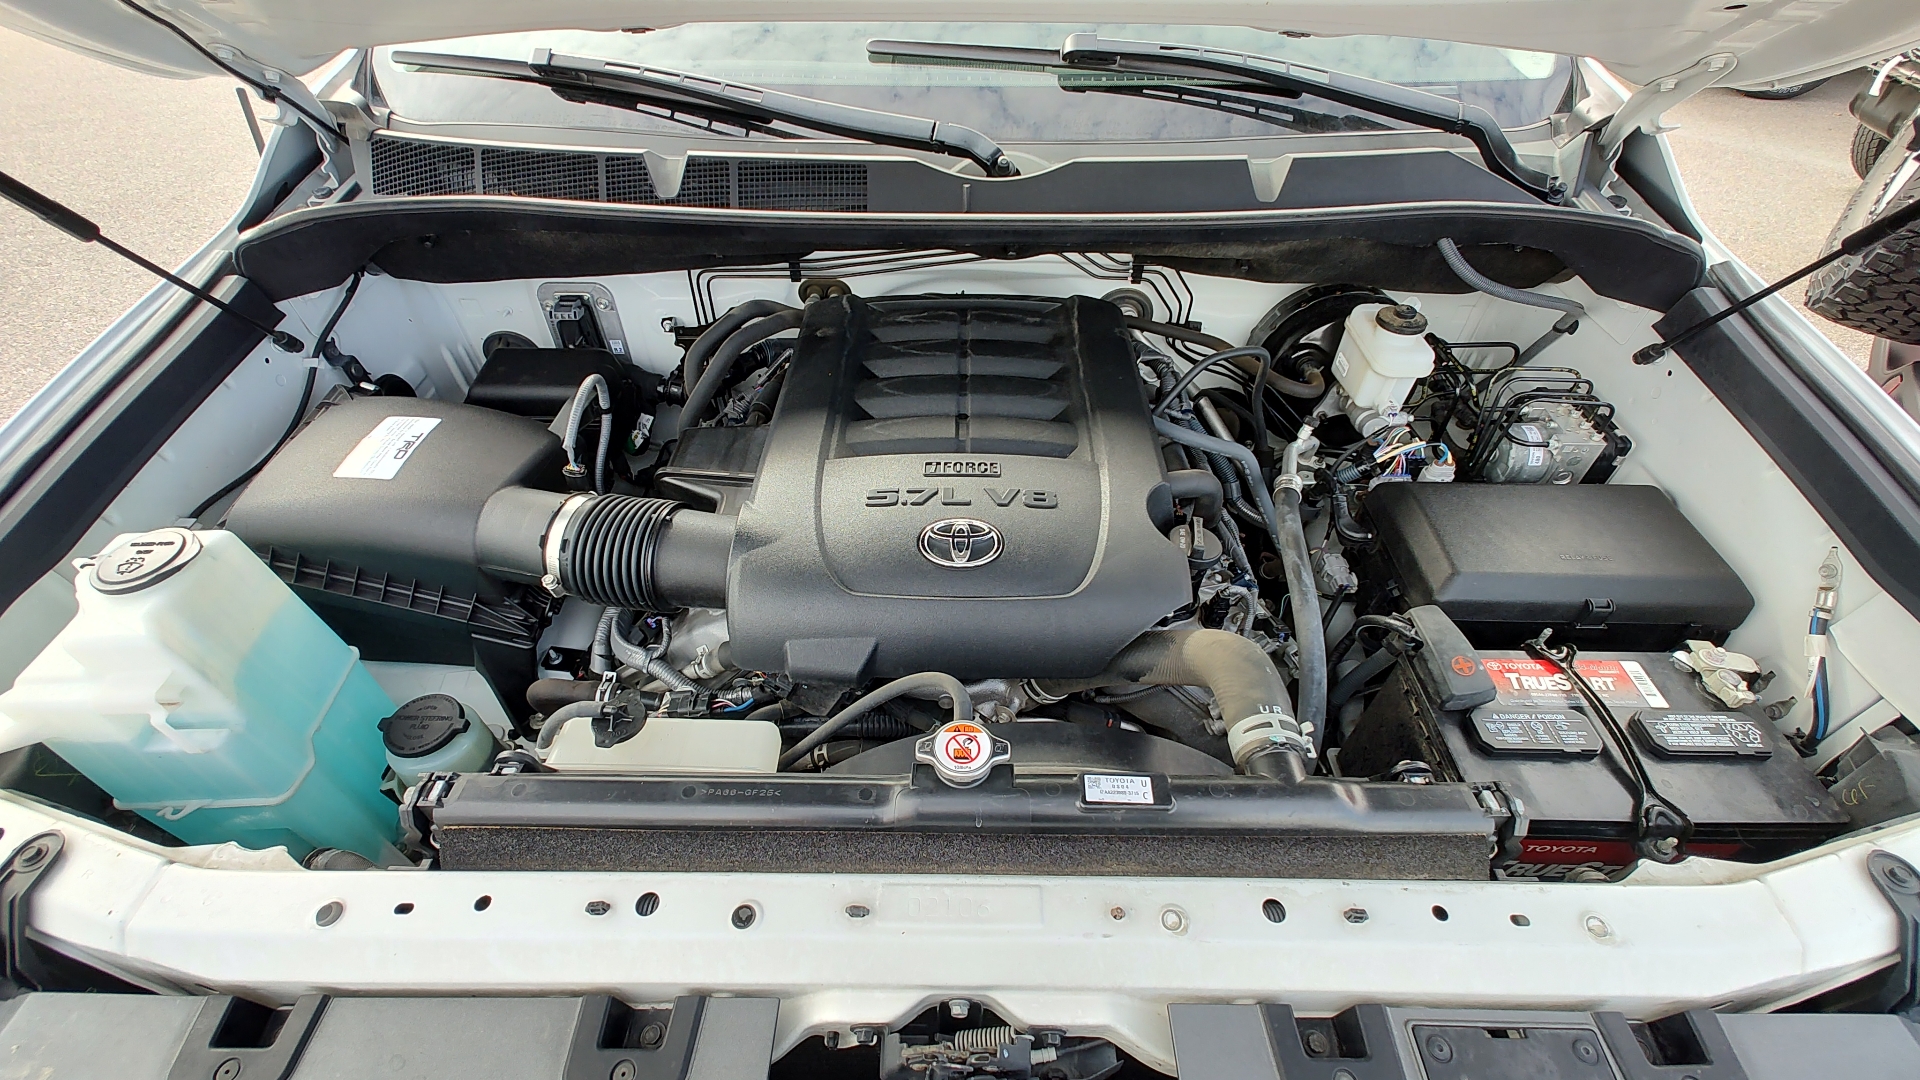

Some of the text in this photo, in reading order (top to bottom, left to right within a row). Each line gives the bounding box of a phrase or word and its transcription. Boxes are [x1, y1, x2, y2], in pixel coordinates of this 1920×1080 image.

[393, 432, 424, 460] TRD
[865, 487, 1058, 509] 5.7L V8
[1503, 662, 1544, 671] TOYOTA
[1525, 845, 1599, 853] TOYOTA
